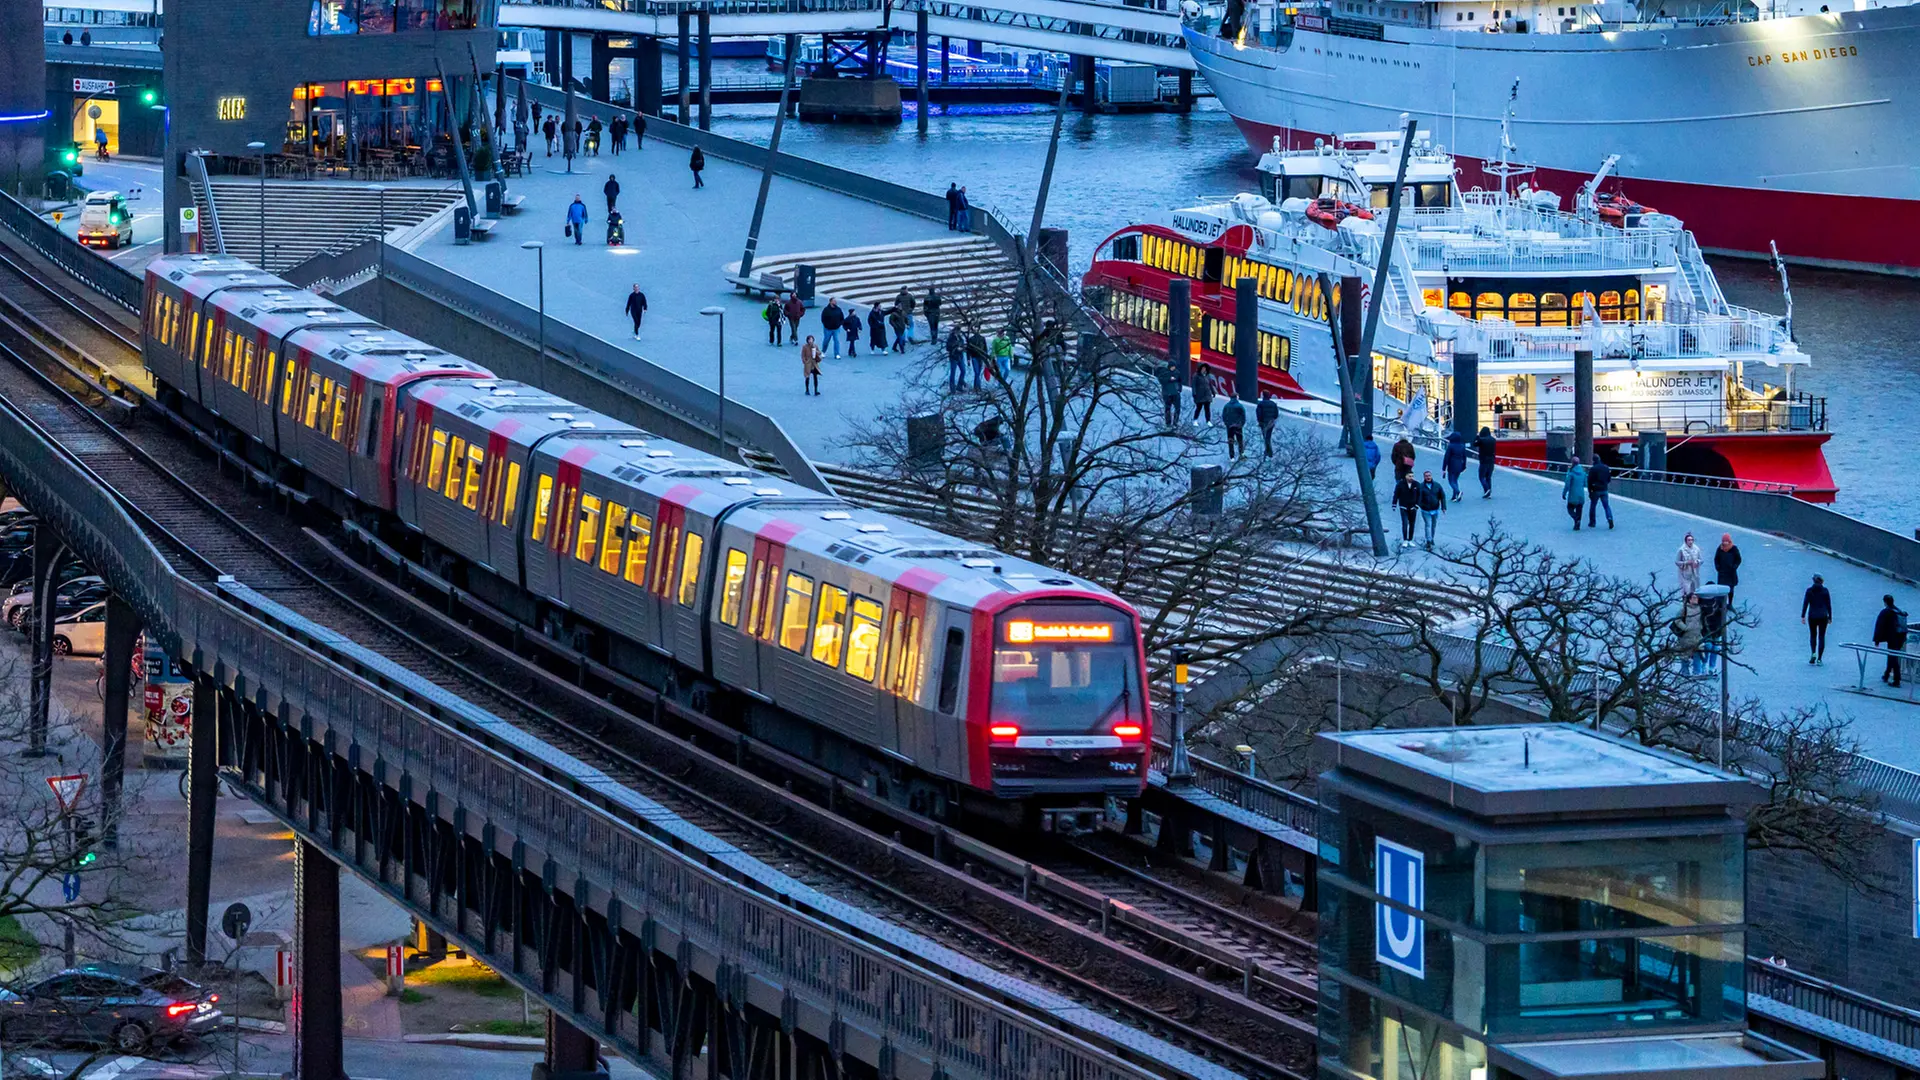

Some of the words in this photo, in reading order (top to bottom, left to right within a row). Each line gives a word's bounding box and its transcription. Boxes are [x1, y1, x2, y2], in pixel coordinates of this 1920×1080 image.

[1747, 55, 1772, 67] CAP
[1781, 51, 1808, 63] SAN
[1813, 46, 1858, 60] DIEGO
[81, 81, 108, 90] AUSFAHRT
[219, 97, 246, 120] ALEX
[1172, 215, 1207, 234] HALUNDER
[1208, 223, 1222, 237] JET
[1555, 385, 1574, 393] FRS
[1630, 377, 1692, 388] HALUNDER
[1694, 377, 1714, 387] JET
[1678, 388, 1714, 396] LIMASSOL
[1383, 851, 1416, 959] U
